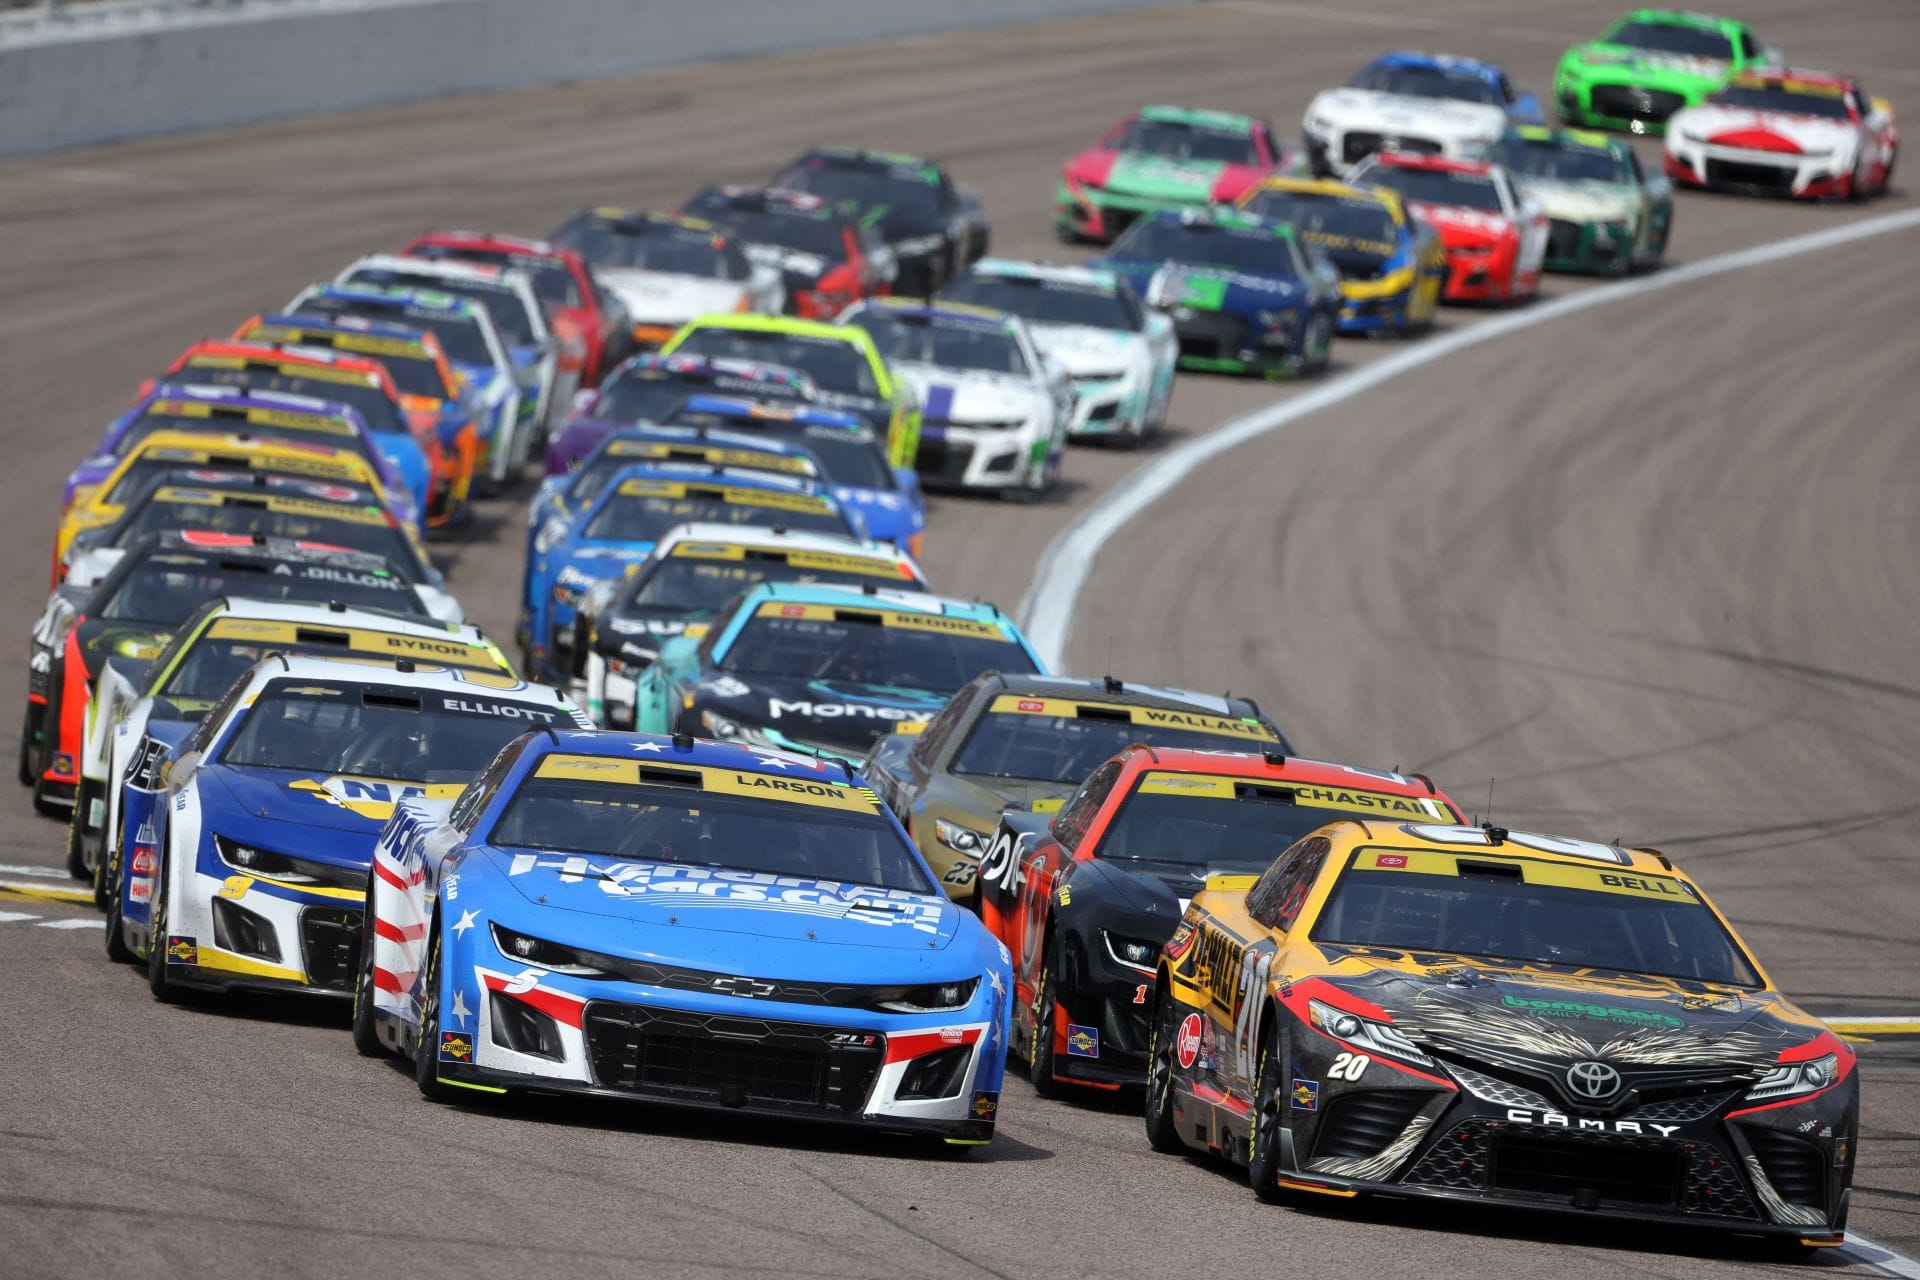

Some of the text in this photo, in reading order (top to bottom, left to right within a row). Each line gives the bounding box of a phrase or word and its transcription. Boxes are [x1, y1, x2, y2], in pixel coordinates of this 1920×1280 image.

[897, 615, 992, 634] REDDICK
[387, 637, 468, 657] BYRON
[443, 698, 556, 724] ELLIOTT
[768, 697, 935, 722] Money
[1146, 711, 1262, 736] WALLACE
[736, 775, 846, 799] LARSON
[942, 861, 979, 886] 23
[1599, 874, 1679, 895] BELL
[218, 875, 255, 900] 9
[170, 946, 197, 958] SUNOCO
[504, 968, 550, 994] 5
[1133, 985, 1147, 1003] 1
[1504, 996, 1681, 1027] bomgaars
[1529, 1009, 1582, 1019] FAMILY
[441, 1042, 472, 1053] SUNOCO
[829, 1033, 875, 1046] ZL1
[1070, 1036, 1096, 1046] SUNOCO
[1327, 1052, 1371, 1082] 20
[1507, 1109, 1681, 1138] CAMRY
